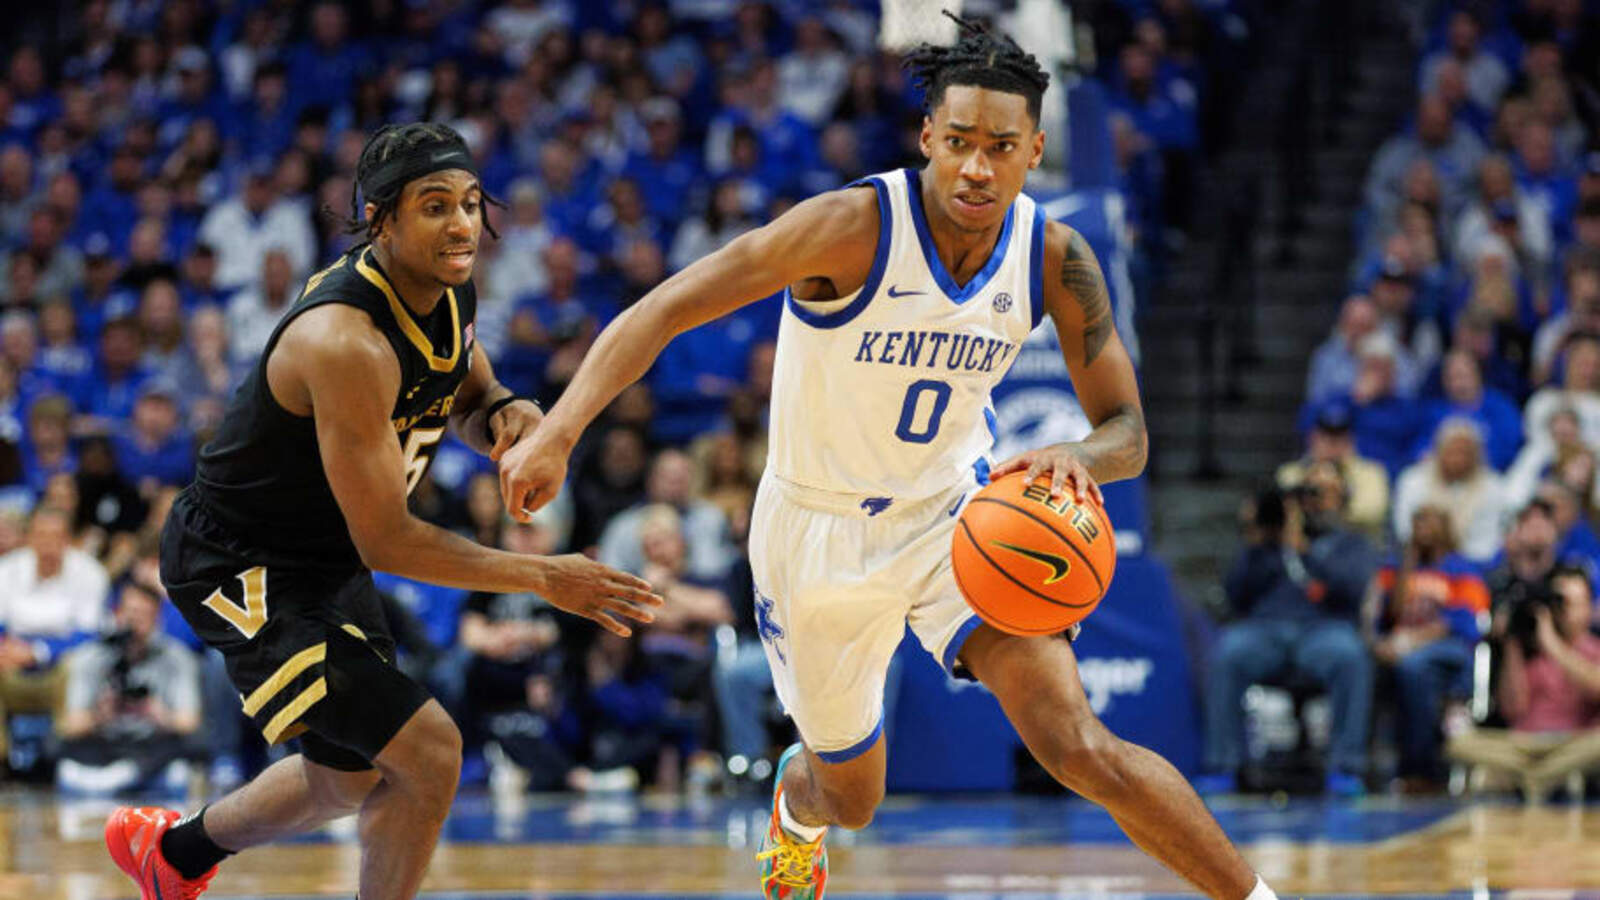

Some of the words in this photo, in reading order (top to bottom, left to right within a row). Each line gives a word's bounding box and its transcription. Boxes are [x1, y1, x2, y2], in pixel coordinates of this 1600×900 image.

[854, 331, 1016, 372] KENTUCKY
[895, 379, 953, 444] 0
[1022, 483, 1099, 544] ELITE
[201, 566, 268, 639] V
